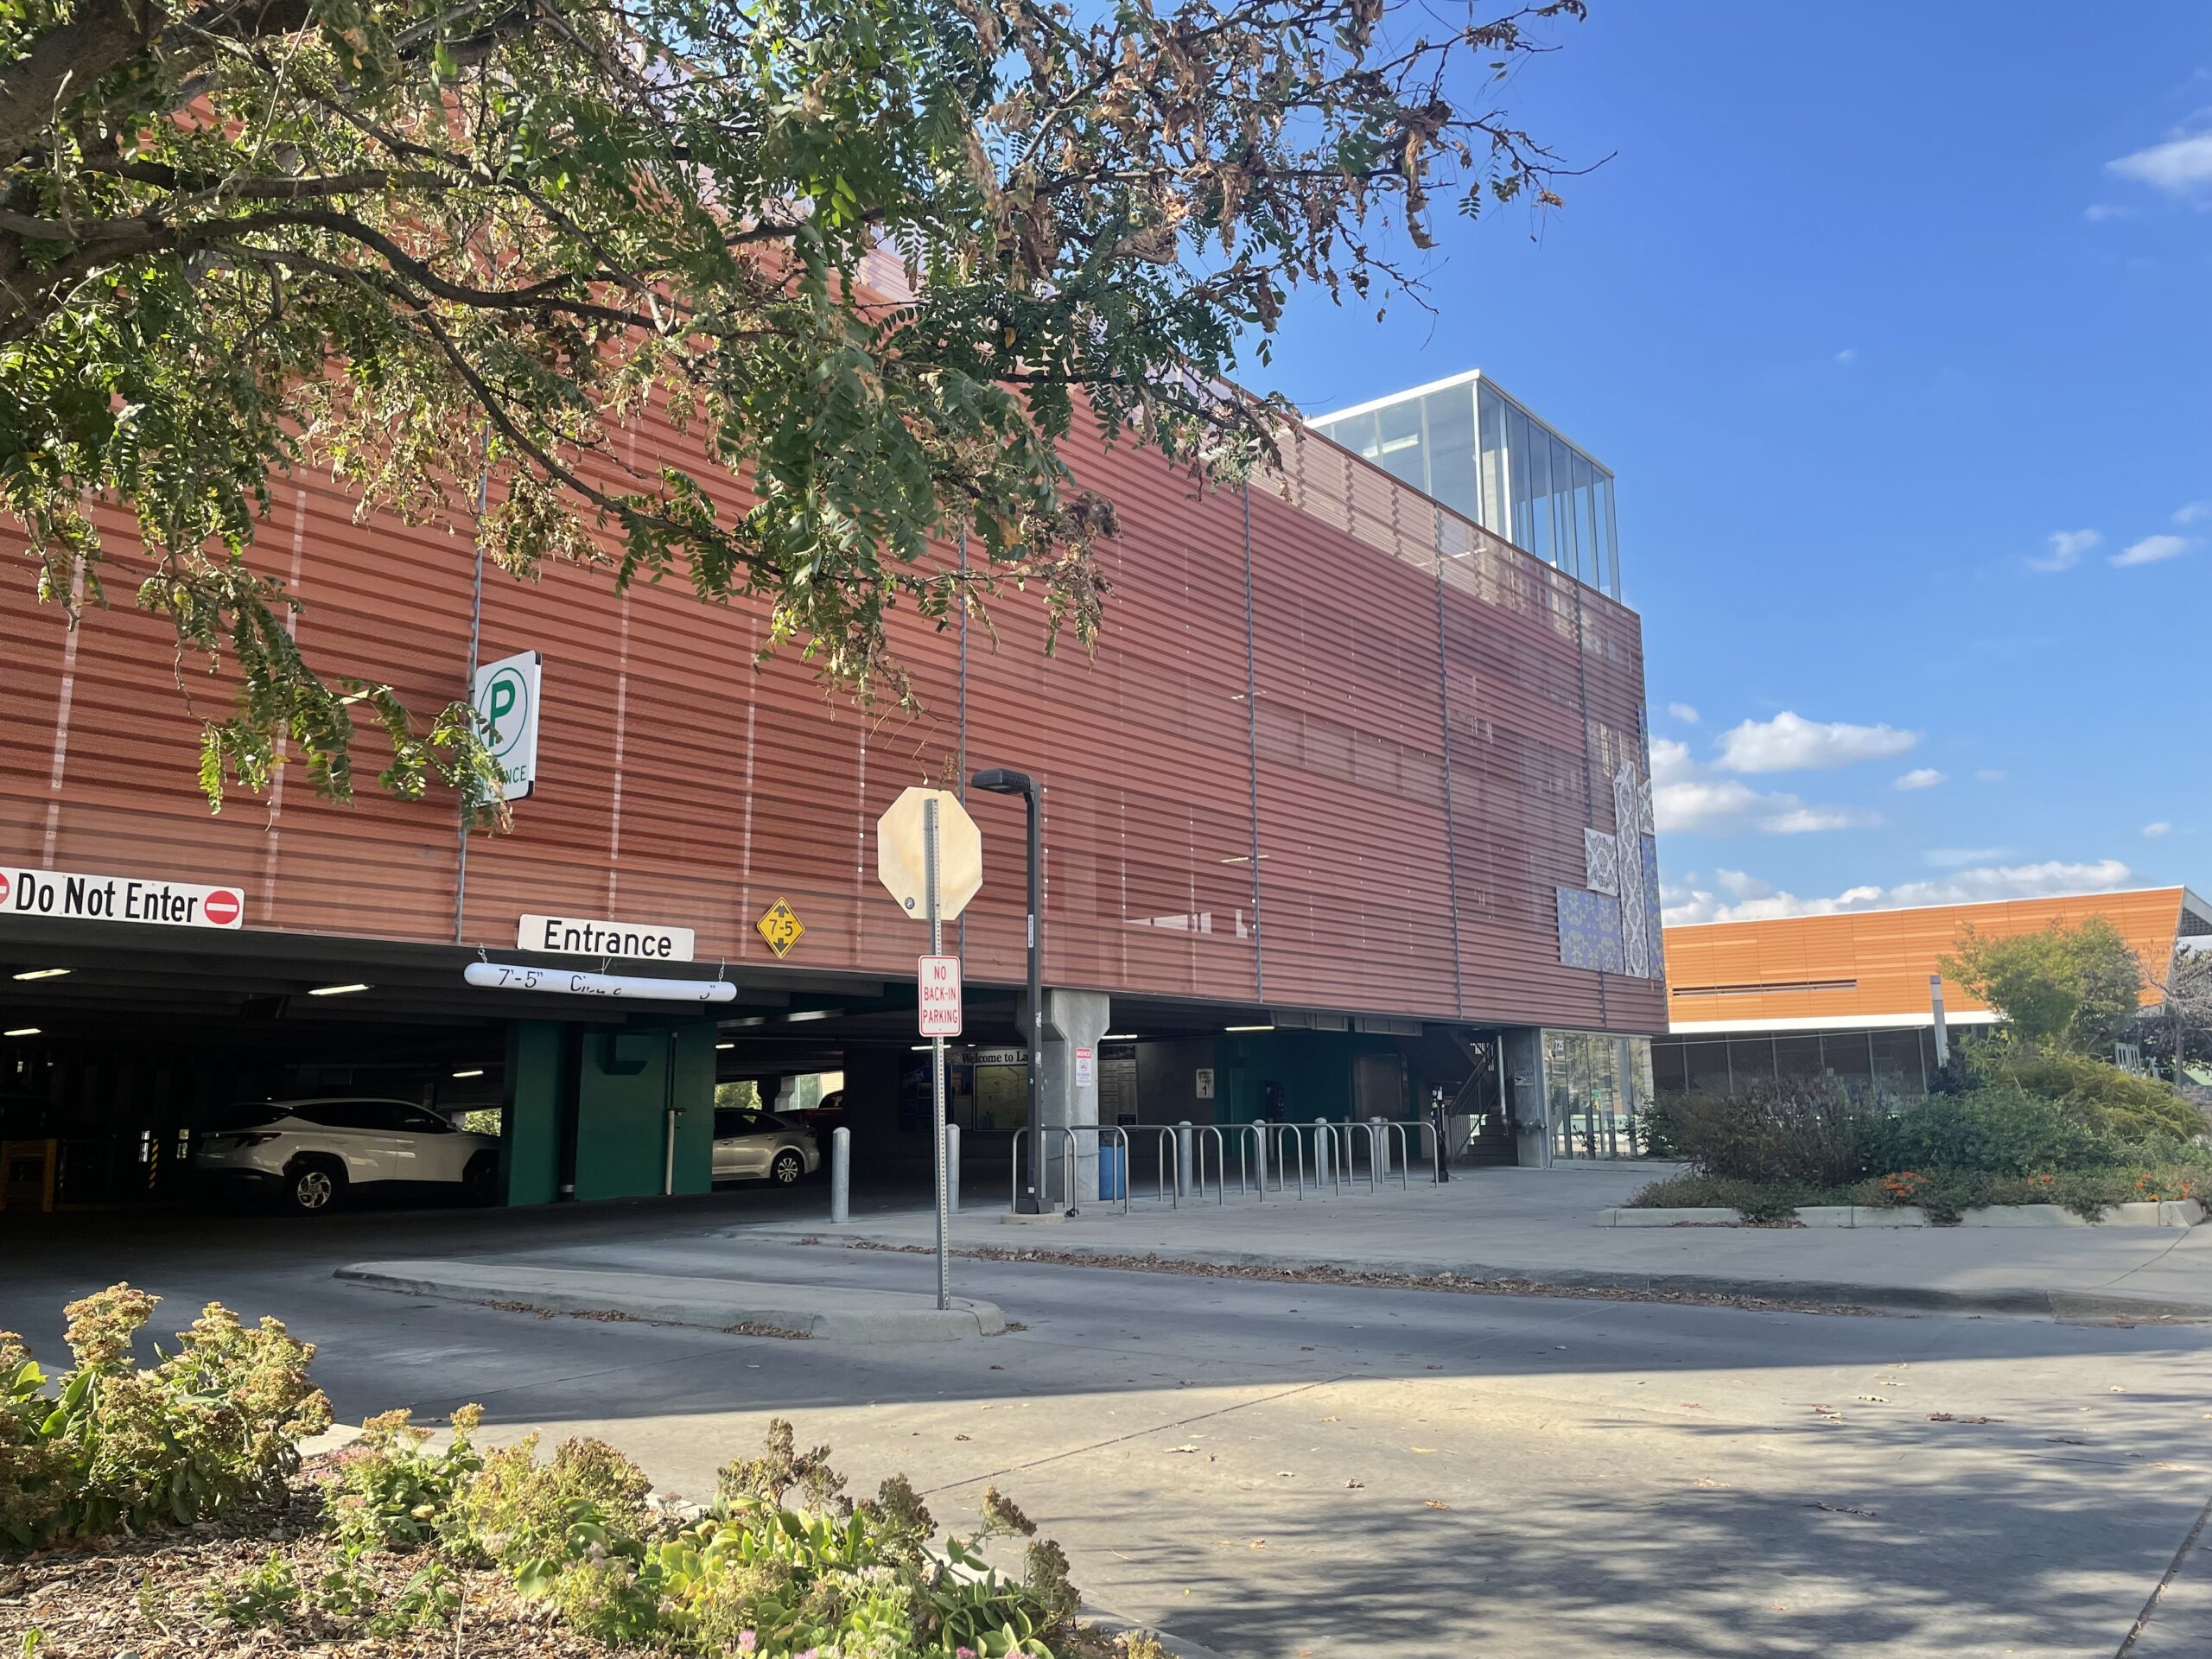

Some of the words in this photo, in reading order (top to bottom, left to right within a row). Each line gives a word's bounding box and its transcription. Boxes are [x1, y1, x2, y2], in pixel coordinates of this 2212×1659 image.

[488, 679, 516, 747] P
[16, 872, 54, 912] Do
[64, 877, 116, 917] Not
[125, 882, 198, 922] Enter
[543, 919, 672, 957] Entrance
[934, 966, 947, 980] NO
[924, 987, 957, 1001] BACK-IN
[923, 1009, 957, 1024] PARKING
[962, 1052, 1002, 1064] Welcome
[1004, 1053, 1014, 1063] to
